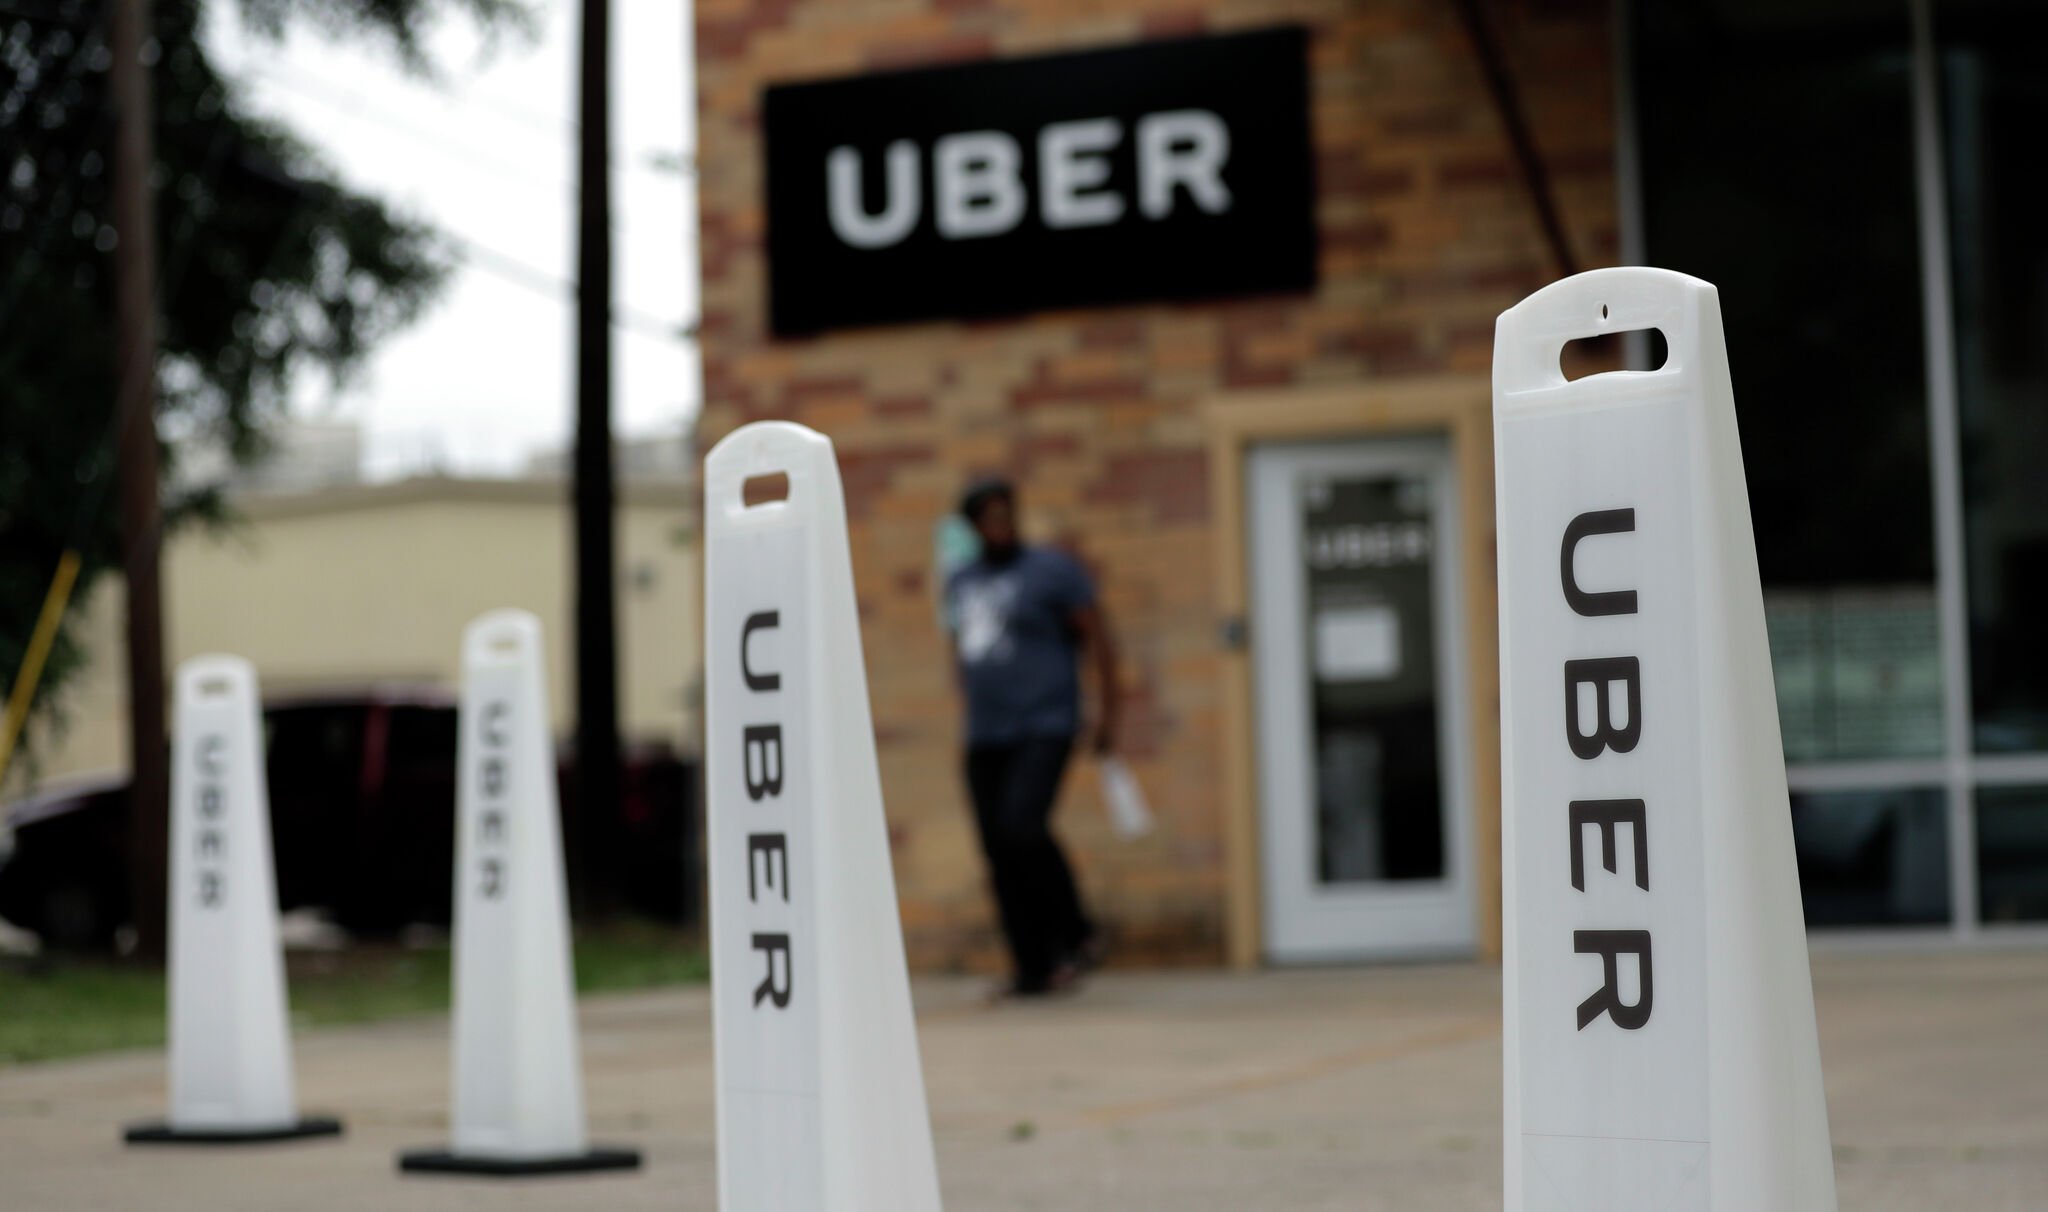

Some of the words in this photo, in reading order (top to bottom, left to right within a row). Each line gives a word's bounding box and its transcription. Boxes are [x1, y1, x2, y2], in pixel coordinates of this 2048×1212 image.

[826, 108, 1232, 249] UBER
[193, 734, 227, 908] UBER
[477, 701, 509, 900] UBER
[740, 609, 793, 1010] UBER
[1560, 507, 1654, 1032] UBER
